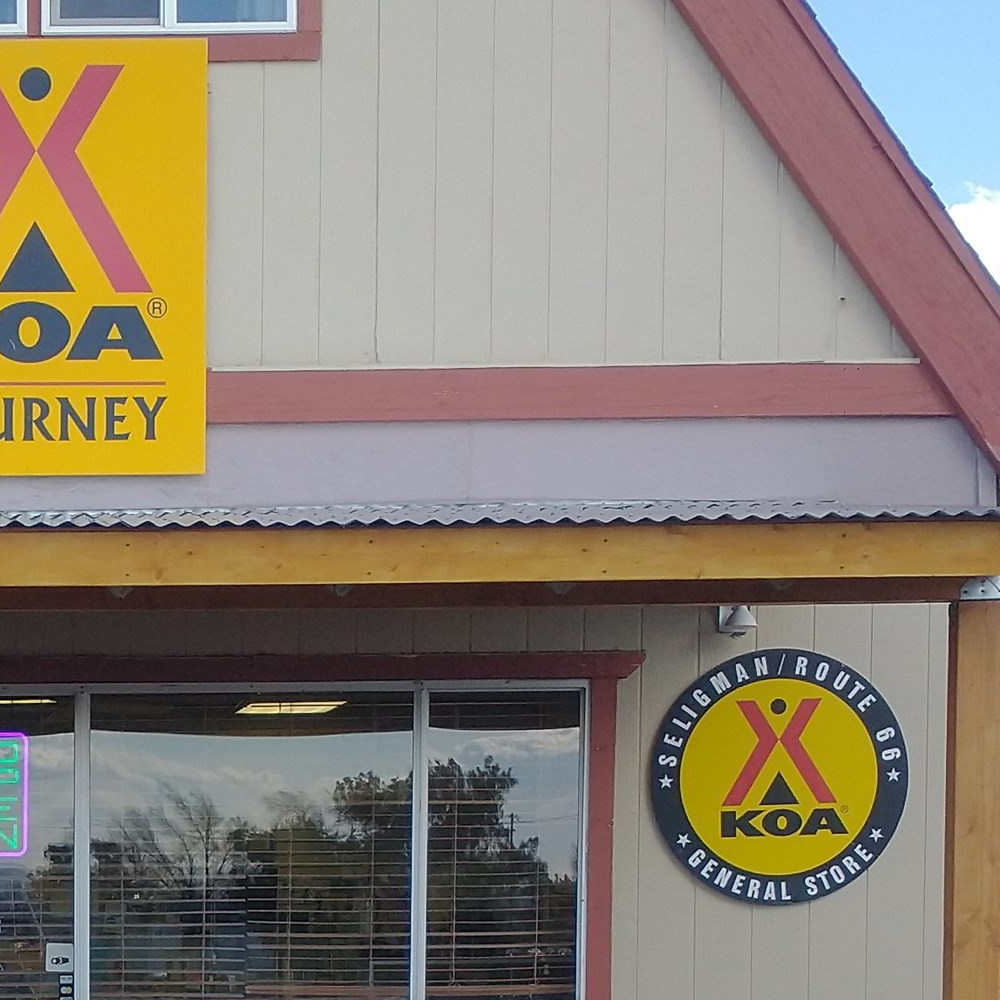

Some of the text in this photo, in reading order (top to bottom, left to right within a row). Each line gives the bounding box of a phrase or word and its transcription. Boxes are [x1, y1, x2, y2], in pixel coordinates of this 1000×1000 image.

[876, 726, 901, 762] 66
[720, 808, 849, 838] KOA
[688, 843, 874, 900] GENERAL STORE
